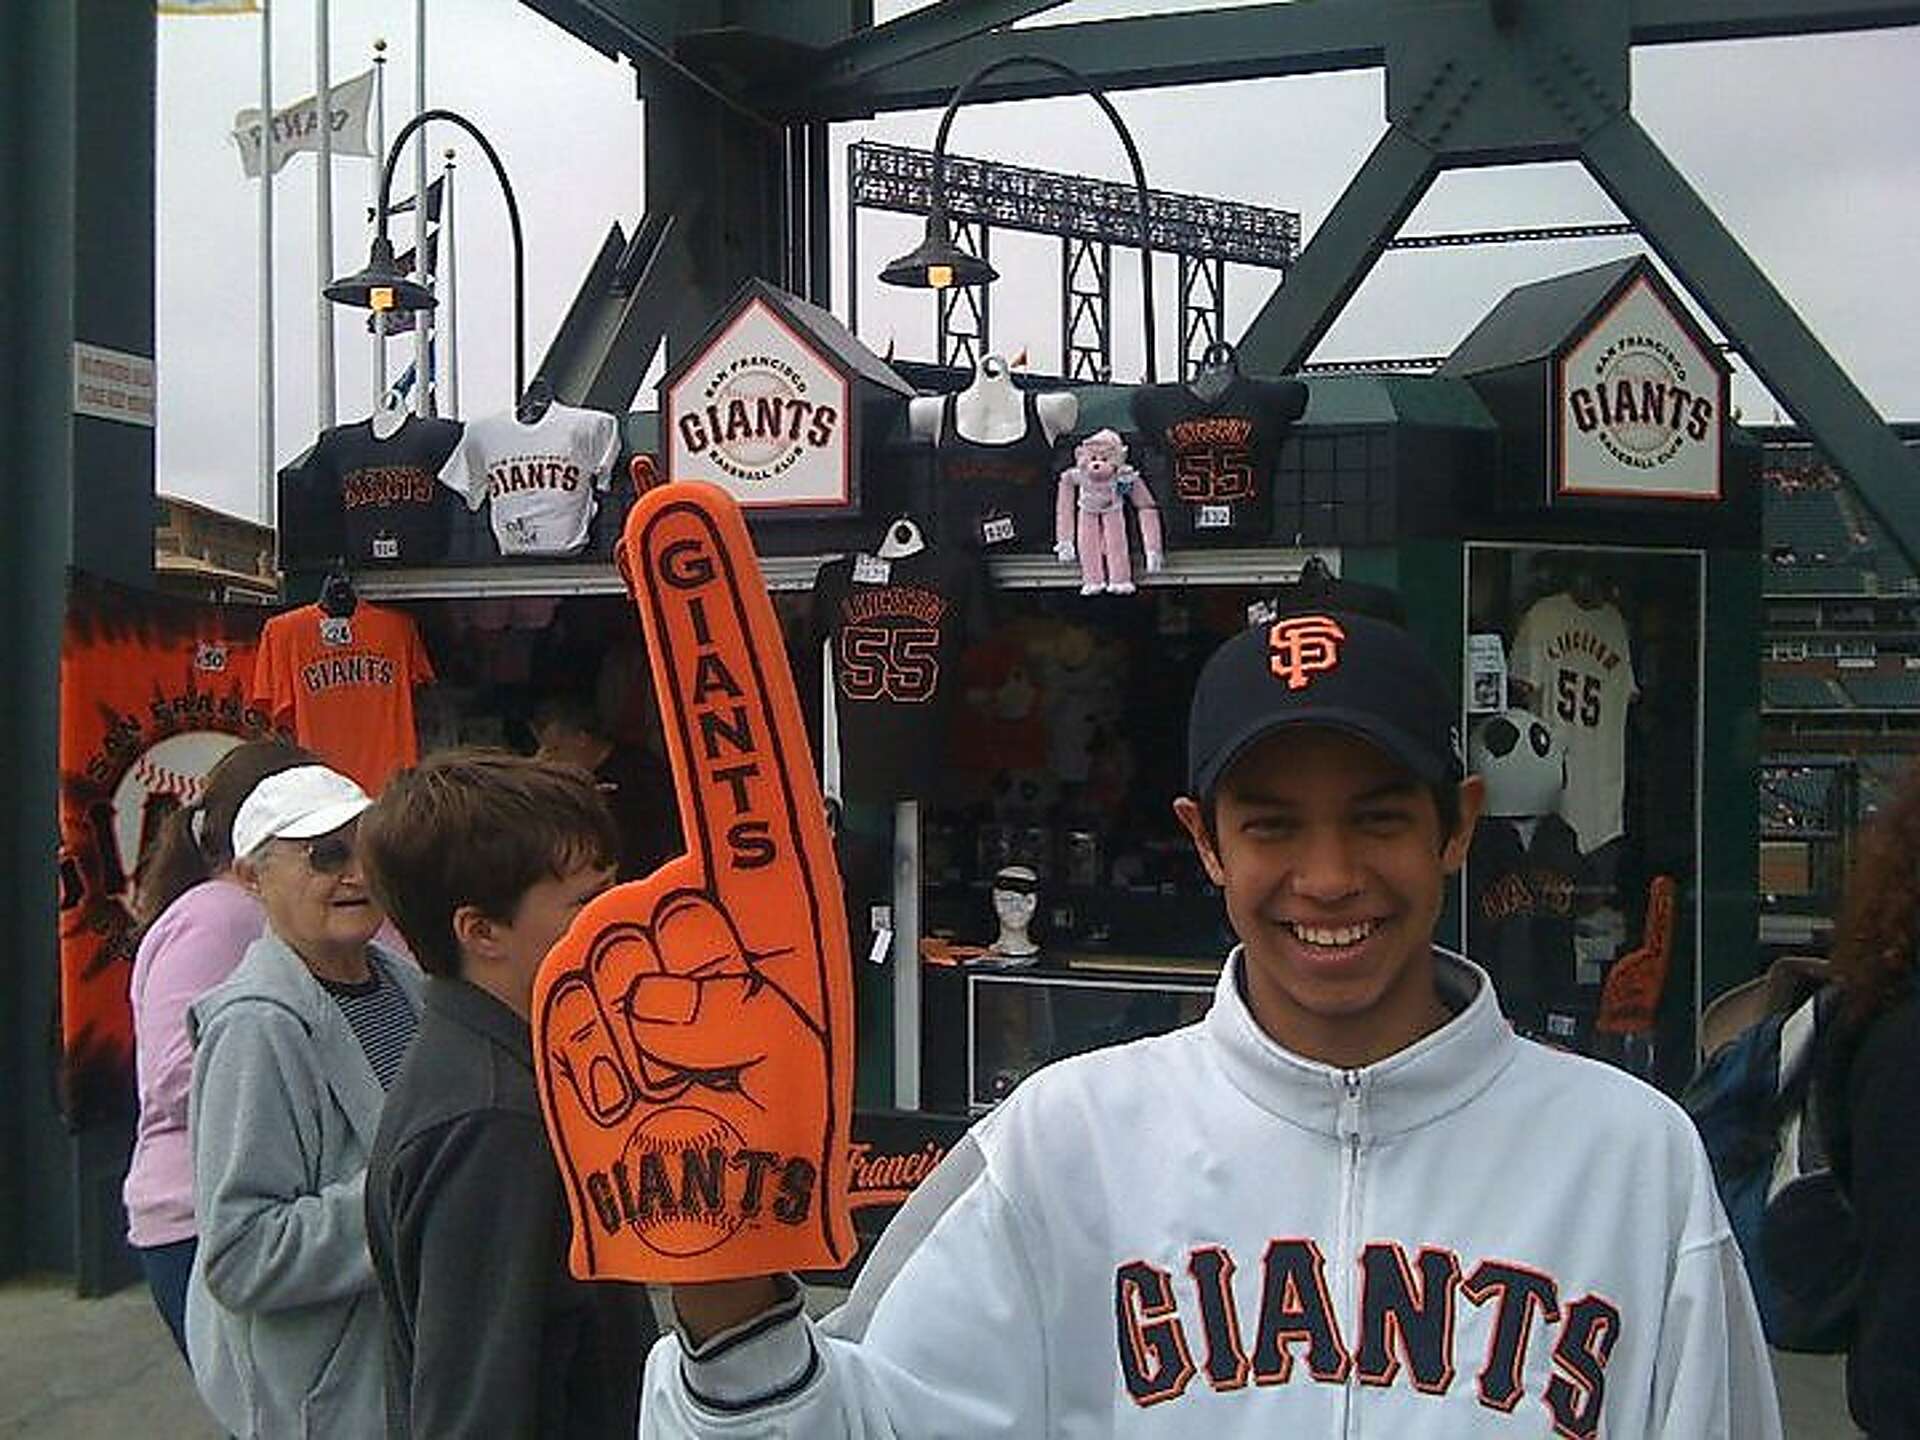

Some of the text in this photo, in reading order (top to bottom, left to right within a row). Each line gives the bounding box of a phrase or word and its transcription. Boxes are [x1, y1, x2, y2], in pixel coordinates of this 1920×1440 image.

[704, 355, 808, 398] SAN FRANCISCO
[1595, 335, 1687, 382] SAN FRANCISCO
[678, 396, 838, 454] GIANTS
[1570, 379, 1714, 442] GIANTS
[1173, 450, 1251, 501] 55
[302, 656, 395, 693] GIANTS
[841, 625, 940, 703] 55
[658, 539, 777, 871] GIANTS
[1556, 668, 1601, 728] 55
[586, 1147, 817, 1237] GIANTS
[1114, 1237, 1623, 1440] GIANTS
